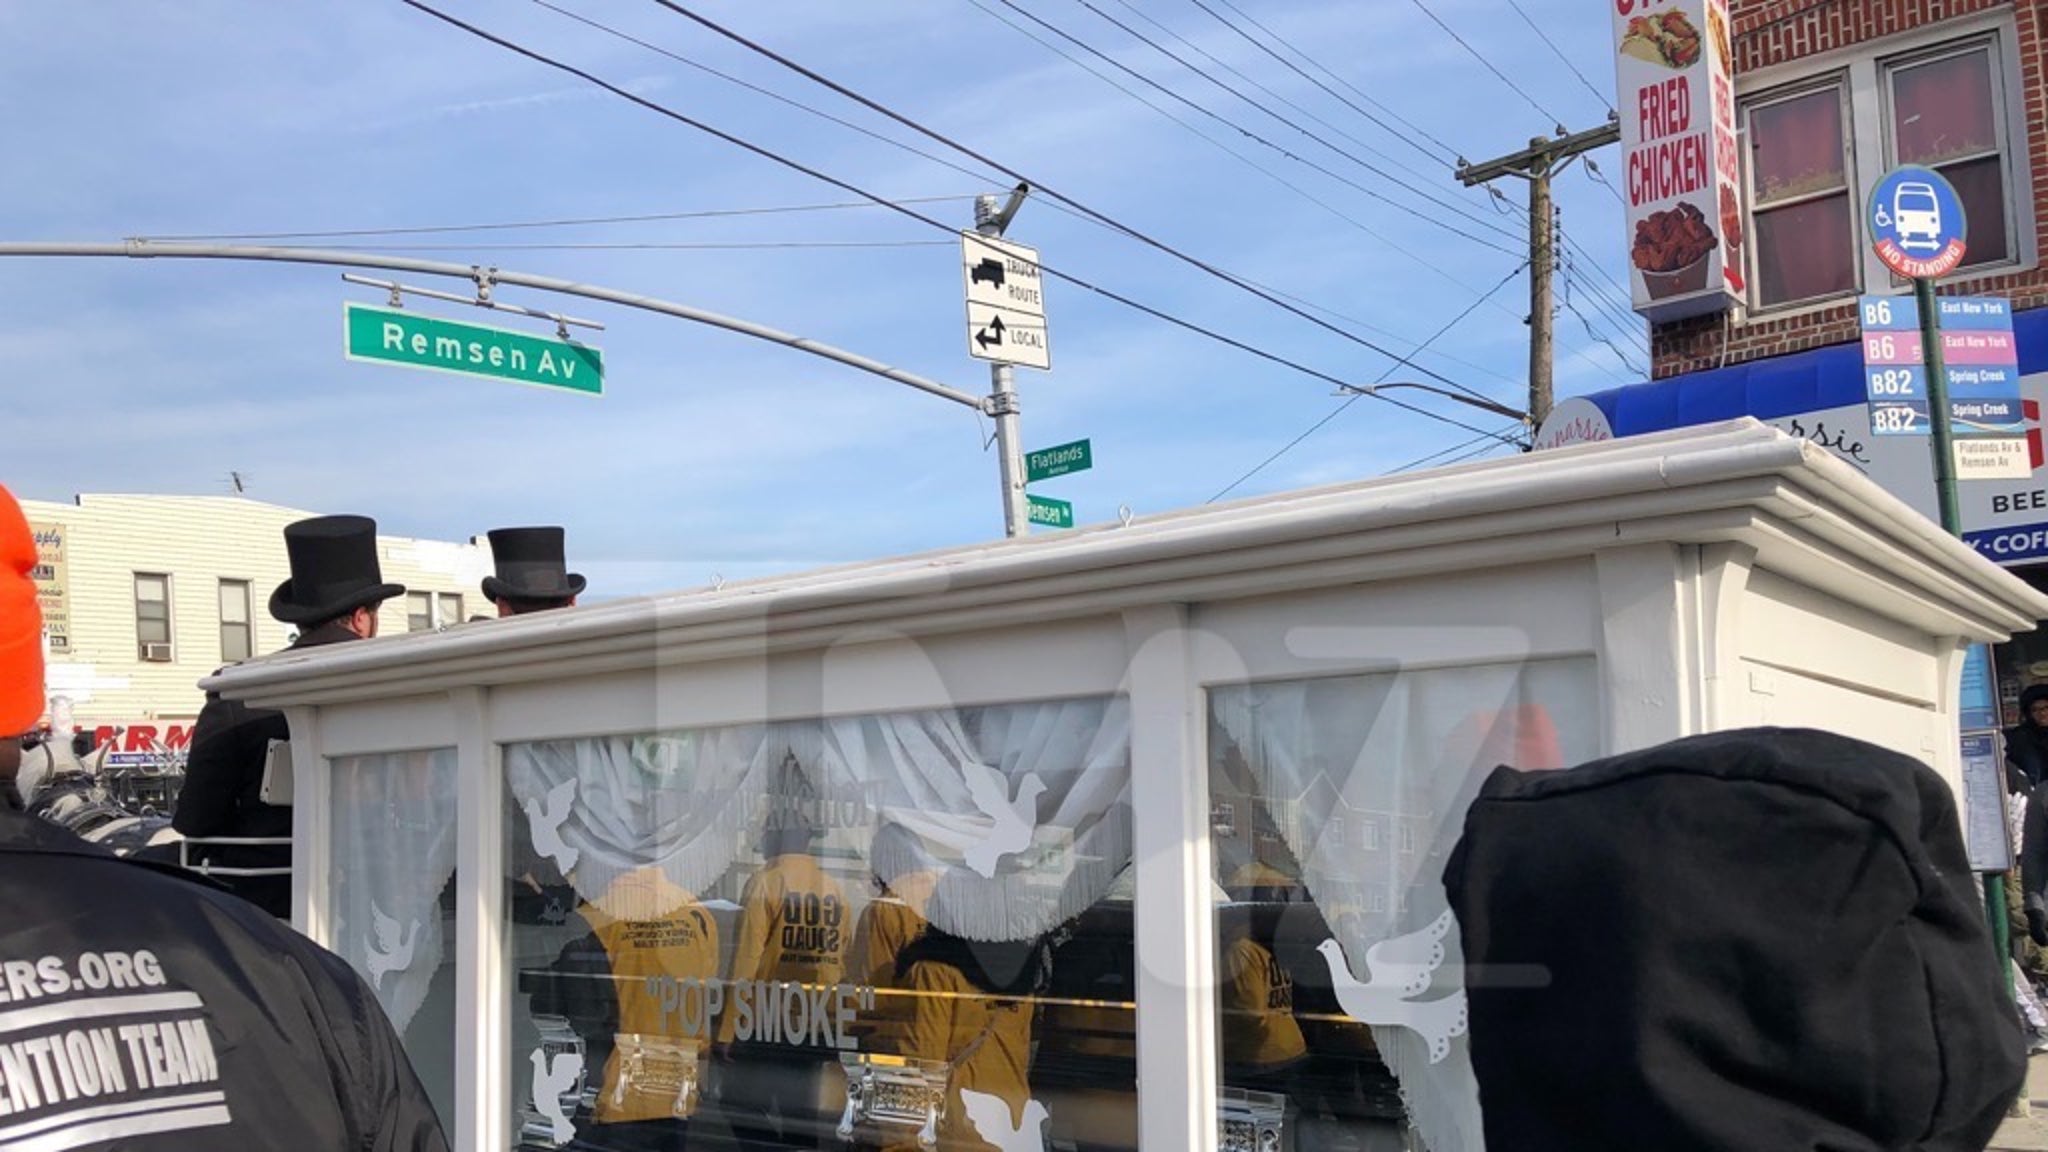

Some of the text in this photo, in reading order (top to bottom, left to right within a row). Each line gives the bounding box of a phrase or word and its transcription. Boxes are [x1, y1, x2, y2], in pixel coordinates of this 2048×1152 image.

[1638, 75, 1690, 143] FRIED
[1629, 132, 1708, 207] CHICKEN
[1006, 258, 1038, 278] TRUCK
[1883, 243, 1960, 276] NO STANDING
[1008, 283, 1040, 305] ROUTE
[1865, 300, 2004, 325] B6 East New York
[383, 322, 576, 379] Remsen Av
[1010, 329, 1044, 349] LOCAL
[1869, 335, 1895, 360] B6
[1945, 335, 1965, 348] East
[1967, 336, 1985, 348] New
[1987, 336, 2007, 348] York
[1871, 369, 2006, 395] B82 Spring Creek
[1874, 403, 2009, 433] B82 Spring Creek
[1031, 445, 1083, 470] Flatlands
[1993, 531, 2048, 554] COF
[733, 977, 875, 1049] SMOKE"
[118, 1019, 219, 1089] TEAM
